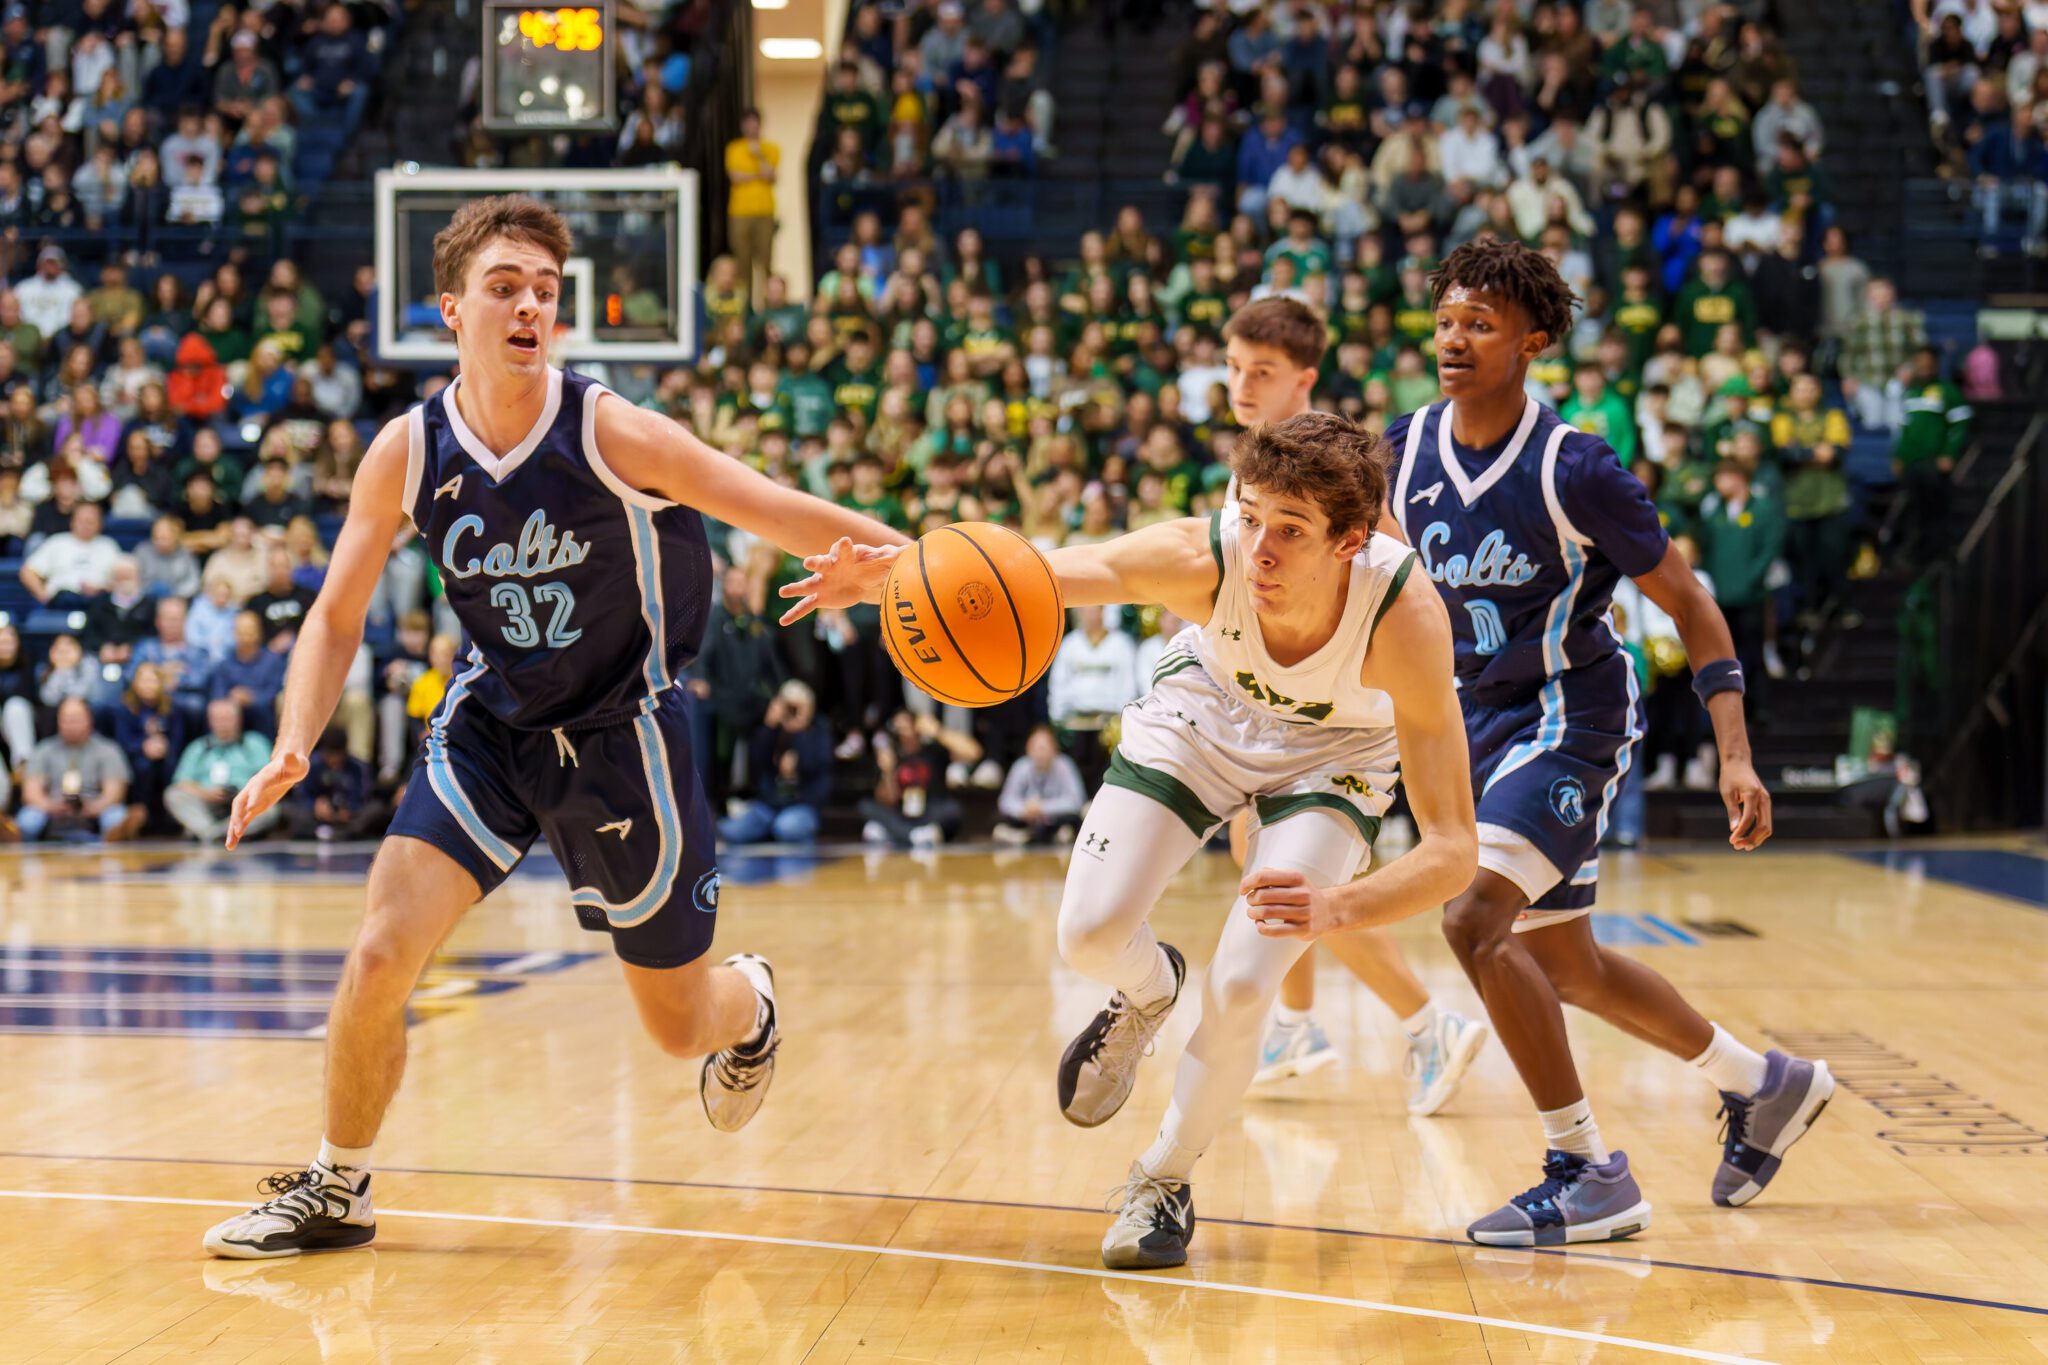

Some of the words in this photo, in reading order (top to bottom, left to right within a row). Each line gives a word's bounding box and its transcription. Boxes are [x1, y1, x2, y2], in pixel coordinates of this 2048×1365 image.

[443, 509, 592, 579] Colts
[1420, 521, 1542, 589] Colts
[490, 581, 583, 648] 32
[896, 601, 941, 663] EVO
